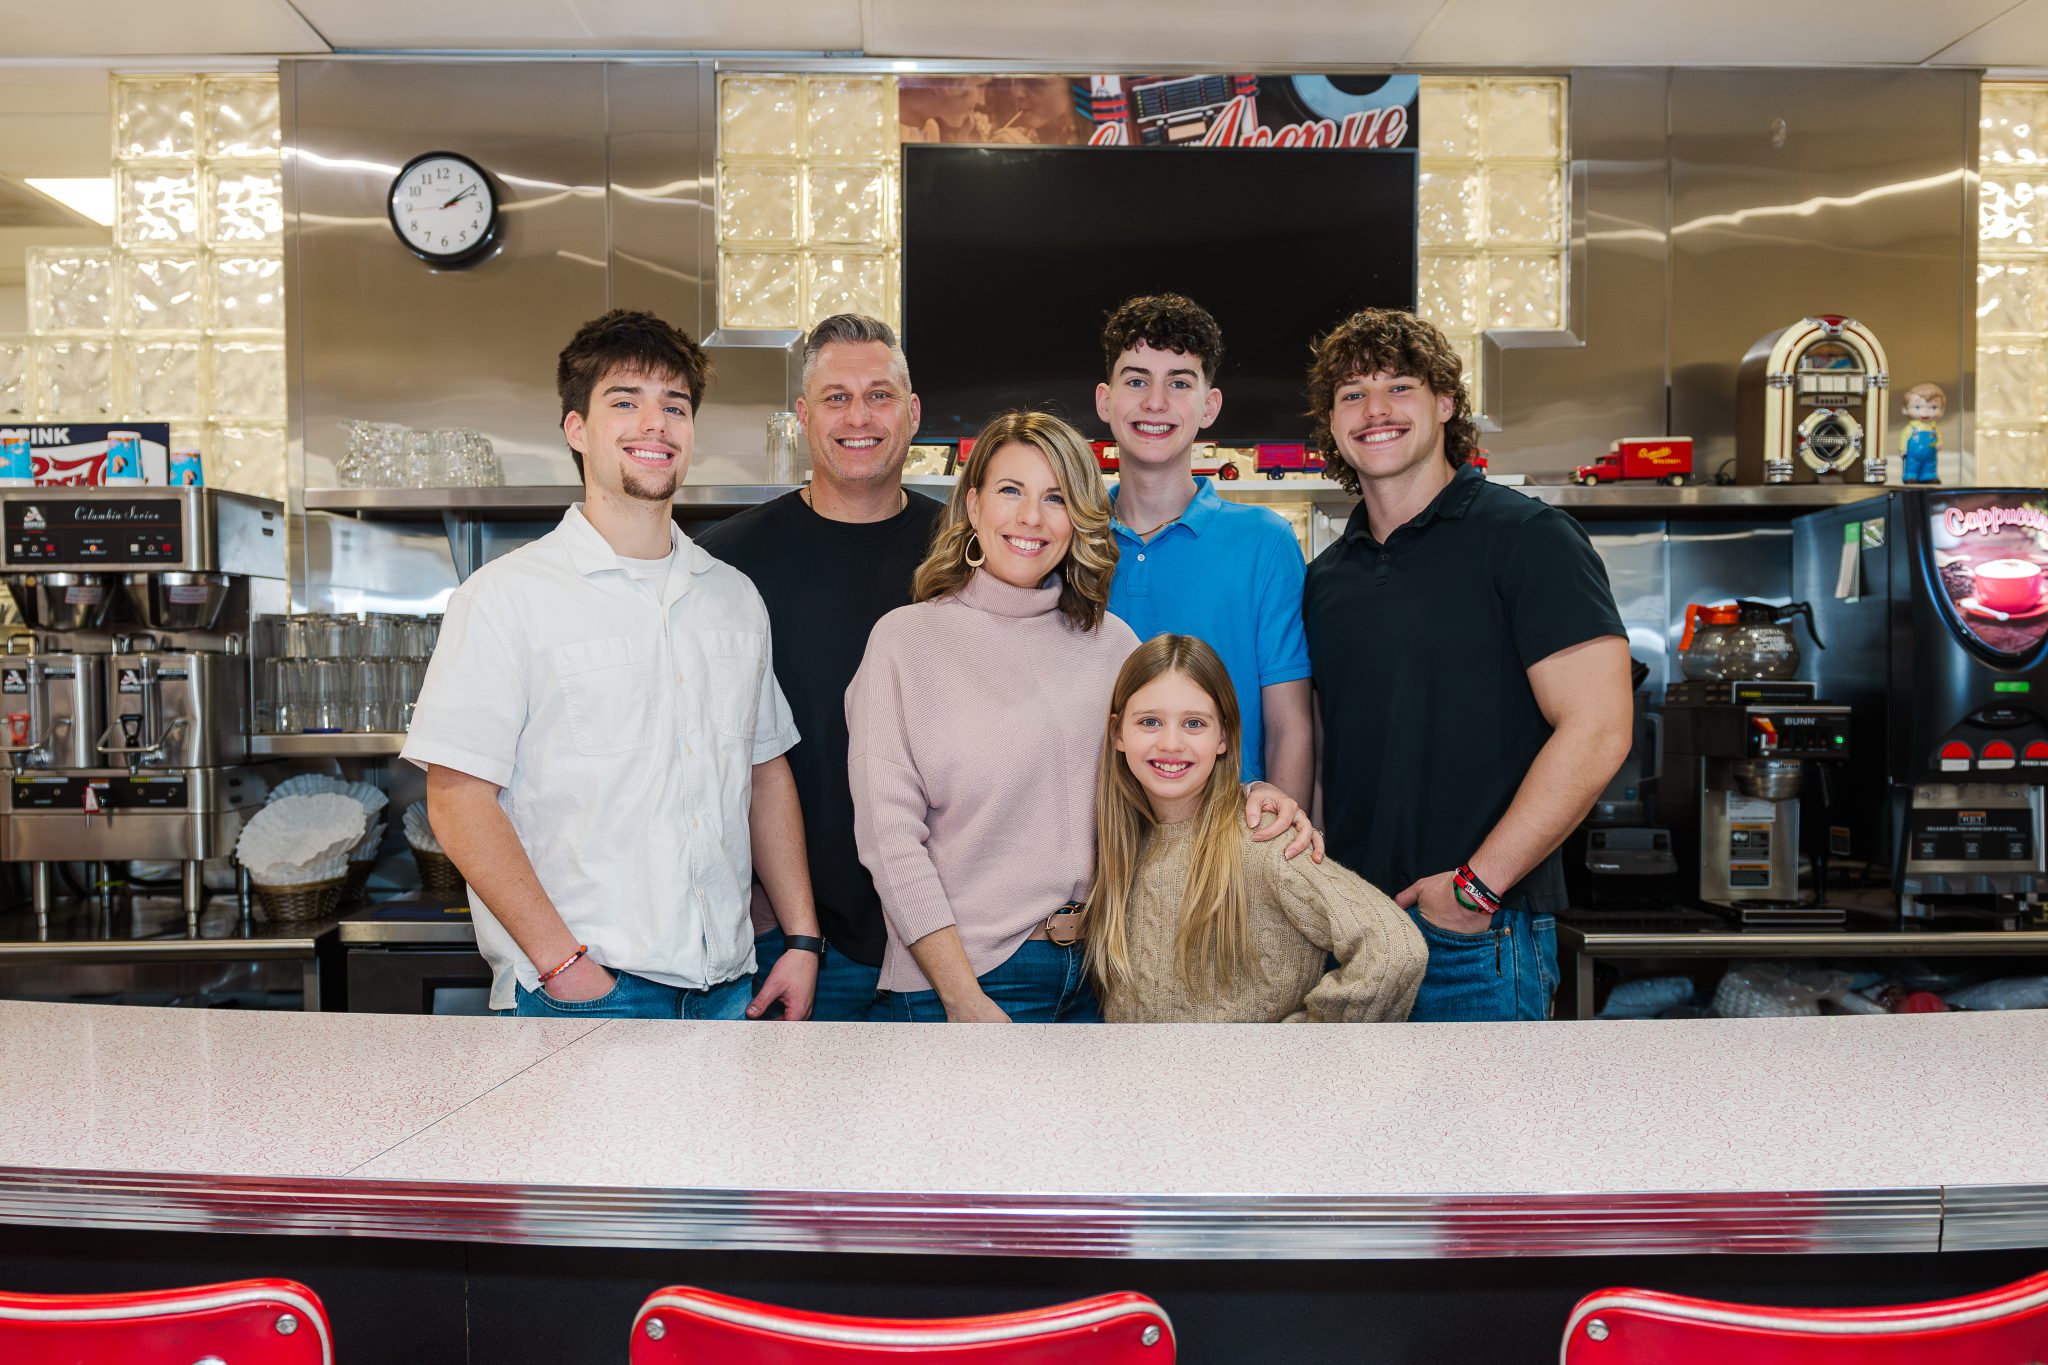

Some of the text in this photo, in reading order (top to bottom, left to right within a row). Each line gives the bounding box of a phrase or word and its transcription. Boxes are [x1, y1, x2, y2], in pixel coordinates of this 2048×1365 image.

[421, 173, 432, 185] 11
[436, 167, 450, 180] 12
[458, 172, 464, 184] 1
[409, 185, 421, 197] 10
[470, 184, 477, 196] 2
[405, 202, 413, 213] 9
[475, 201, 483, 213] 3
[410, 220, 418, 231] 8
[471, 219, 478, 230] 4
[424, 231, 431, 242] 7
[441, 235, 448, 247] 6
[459, 231, 466, 242] 5
[1, 427, 71, 445] INK
[1783, 717, 1815, 726] BUNN
